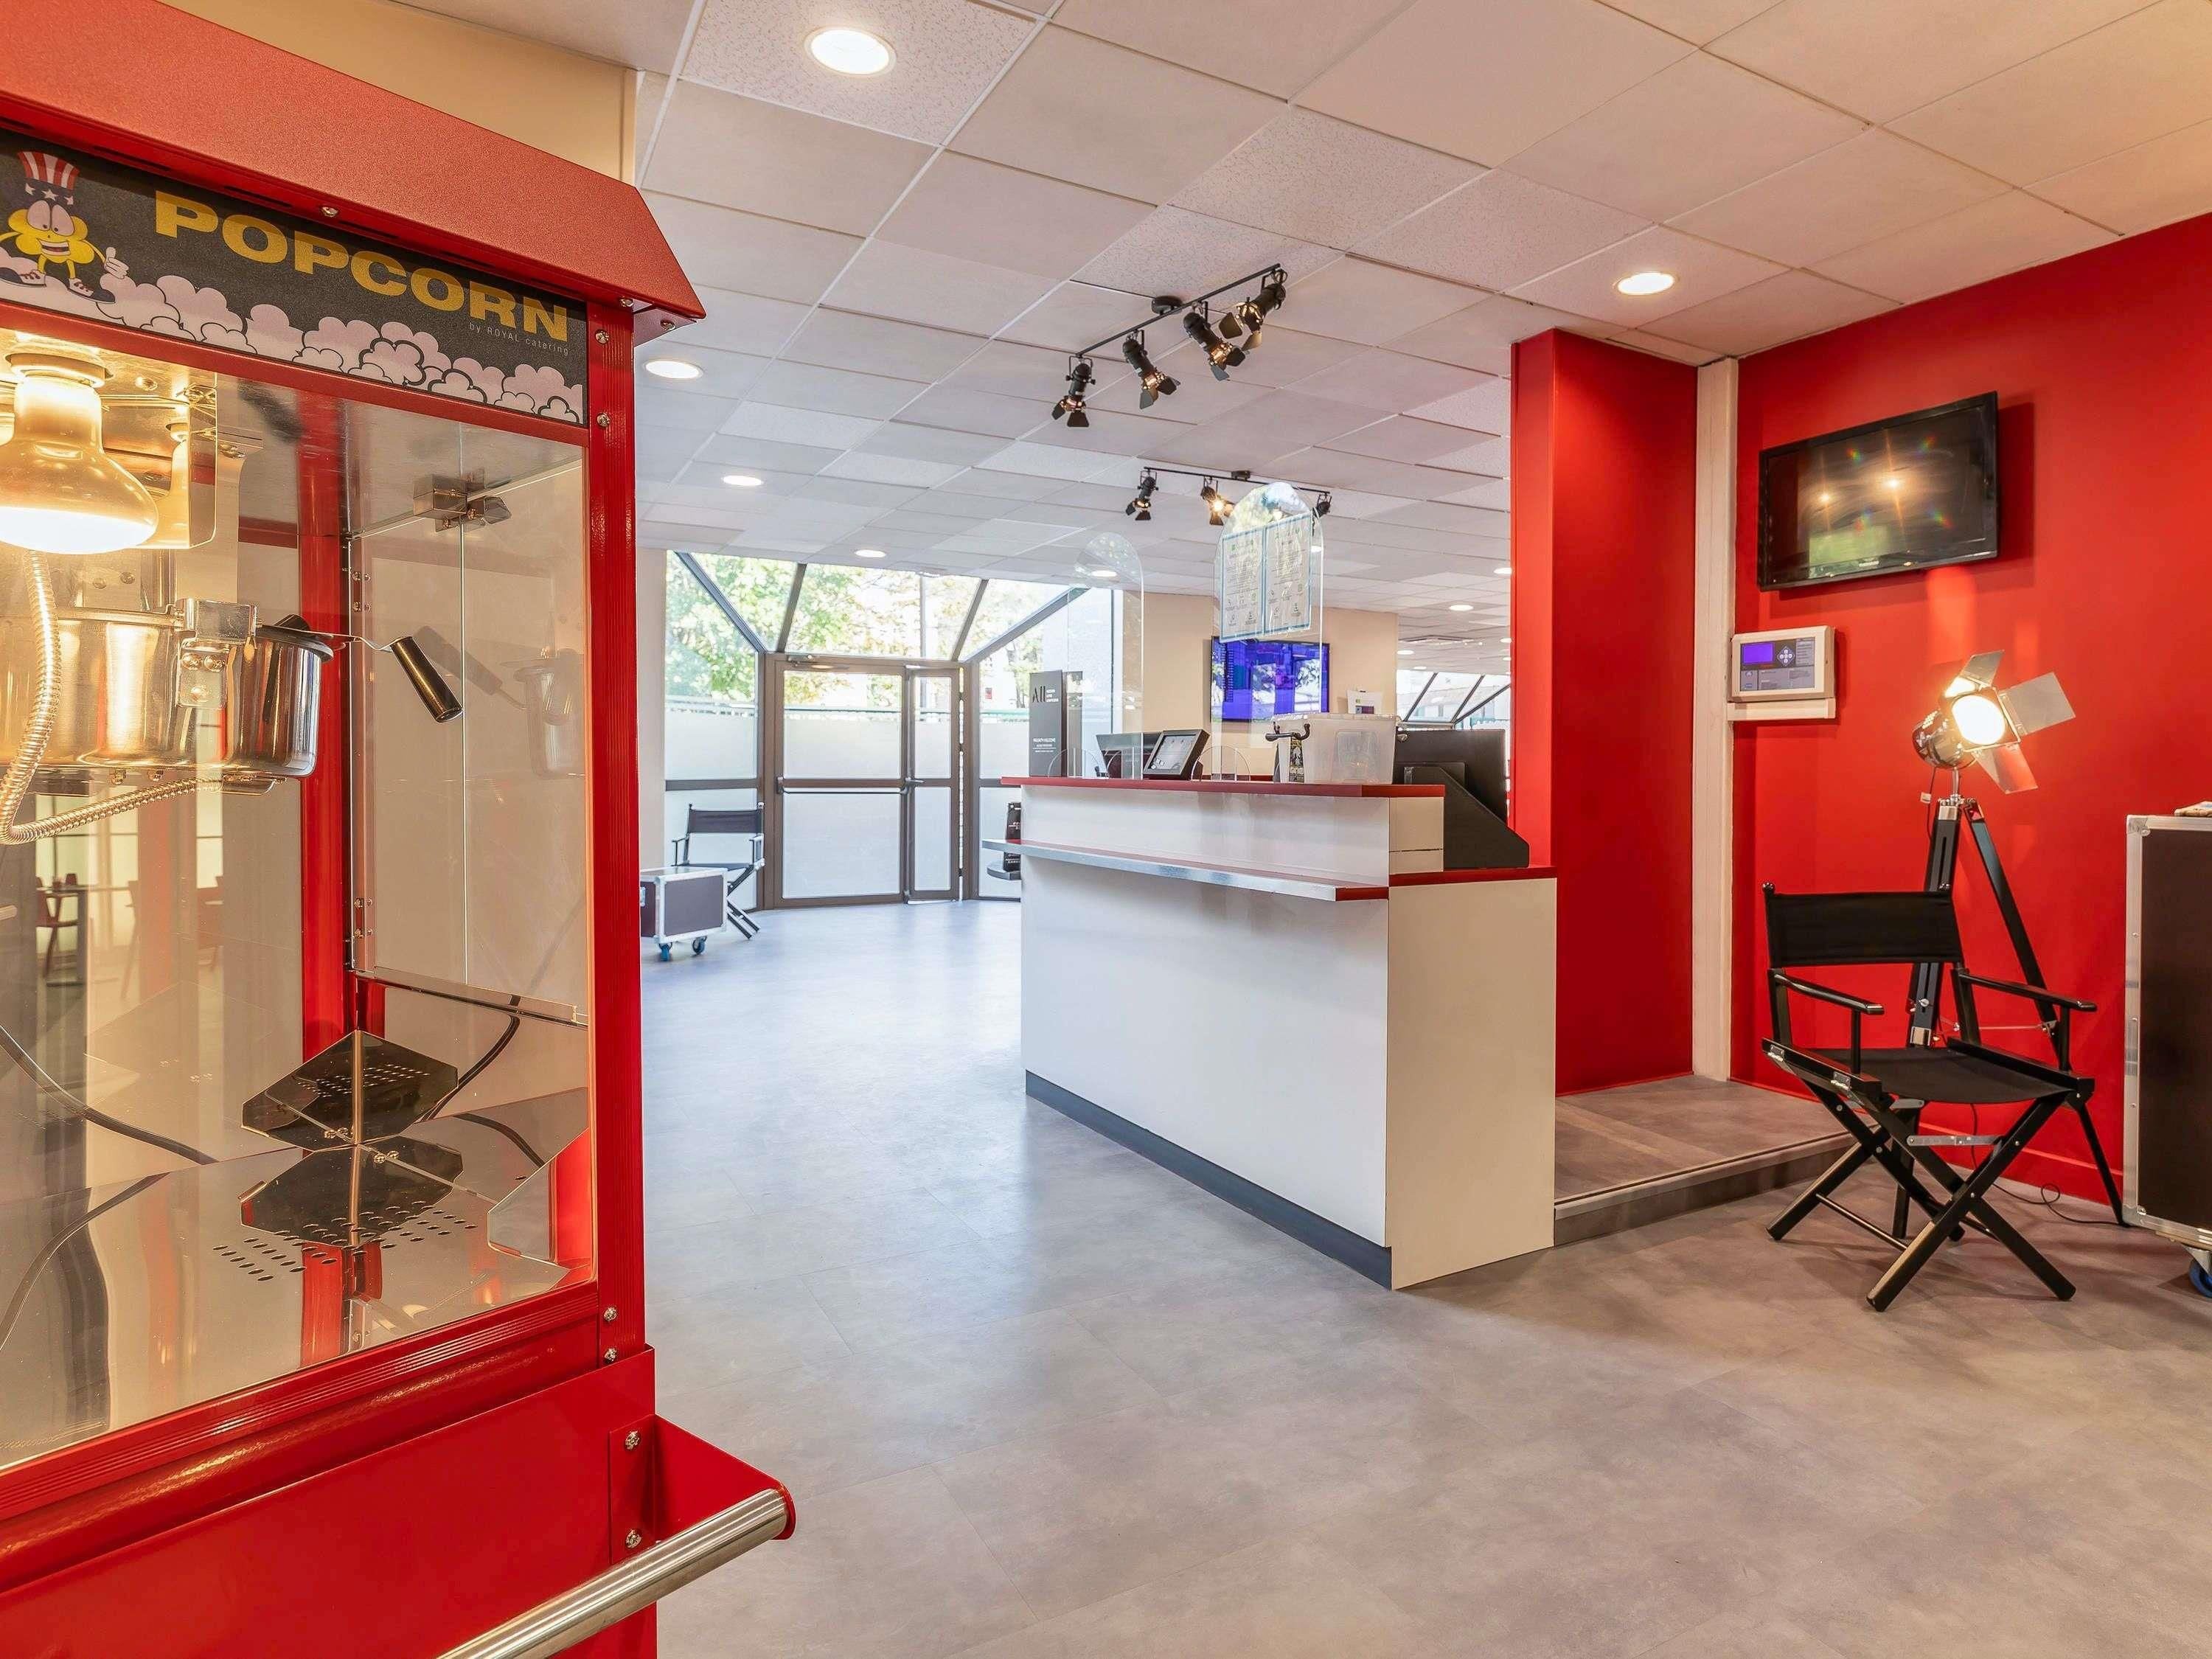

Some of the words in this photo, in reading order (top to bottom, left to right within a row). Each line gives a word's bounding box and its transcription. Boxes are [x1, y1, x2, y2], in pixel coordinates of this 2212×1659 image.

[155, 191, 568, 342] POPCORN
[469, 321, 481, 333] by
[487, 327, 520, 342] ROYAL
[525, 337, 569, 356] catering
